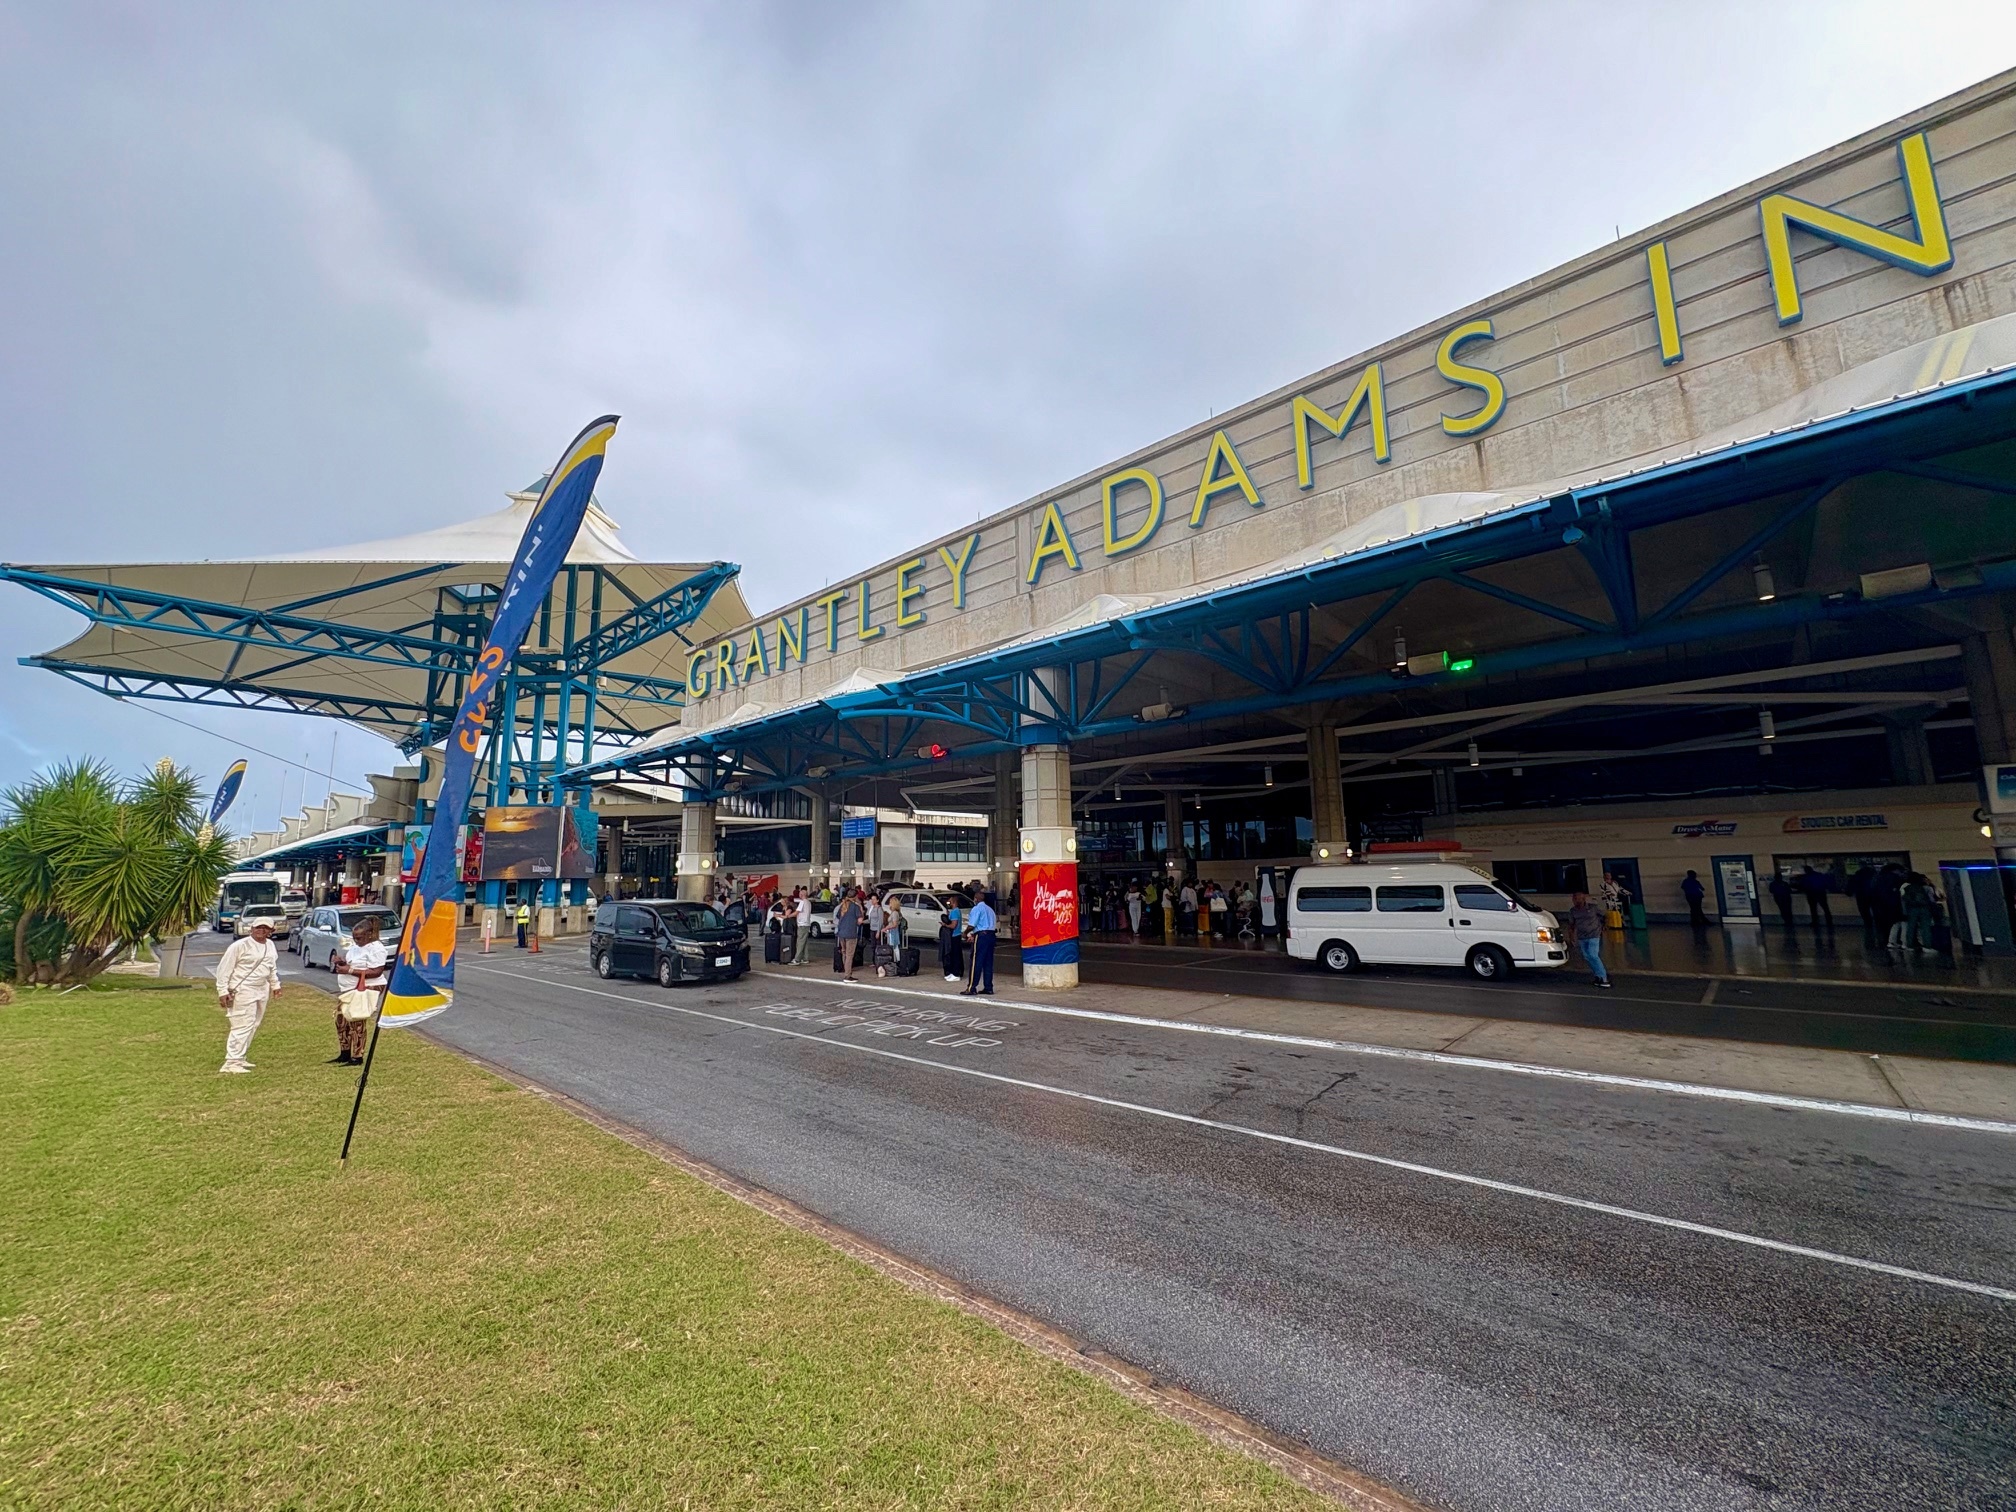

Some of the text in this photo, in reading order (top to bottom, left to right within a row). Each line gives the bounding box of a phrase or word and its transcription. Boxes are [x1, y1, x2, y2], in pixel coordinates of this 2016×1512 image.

[688, 533, 981, 699] GRANTLEY
[1026, 319, 1507, 585] ADAMS
[1837, 816, 1854, 827] CAR
[1856, 814, 1888, 827] RENTAL
[1053, 910, 1073, 925] 2025
[749, 1003, 1003, 1048] PUBLIC PICK UP
[825, 998, 1019, 1032] NO PARKING
